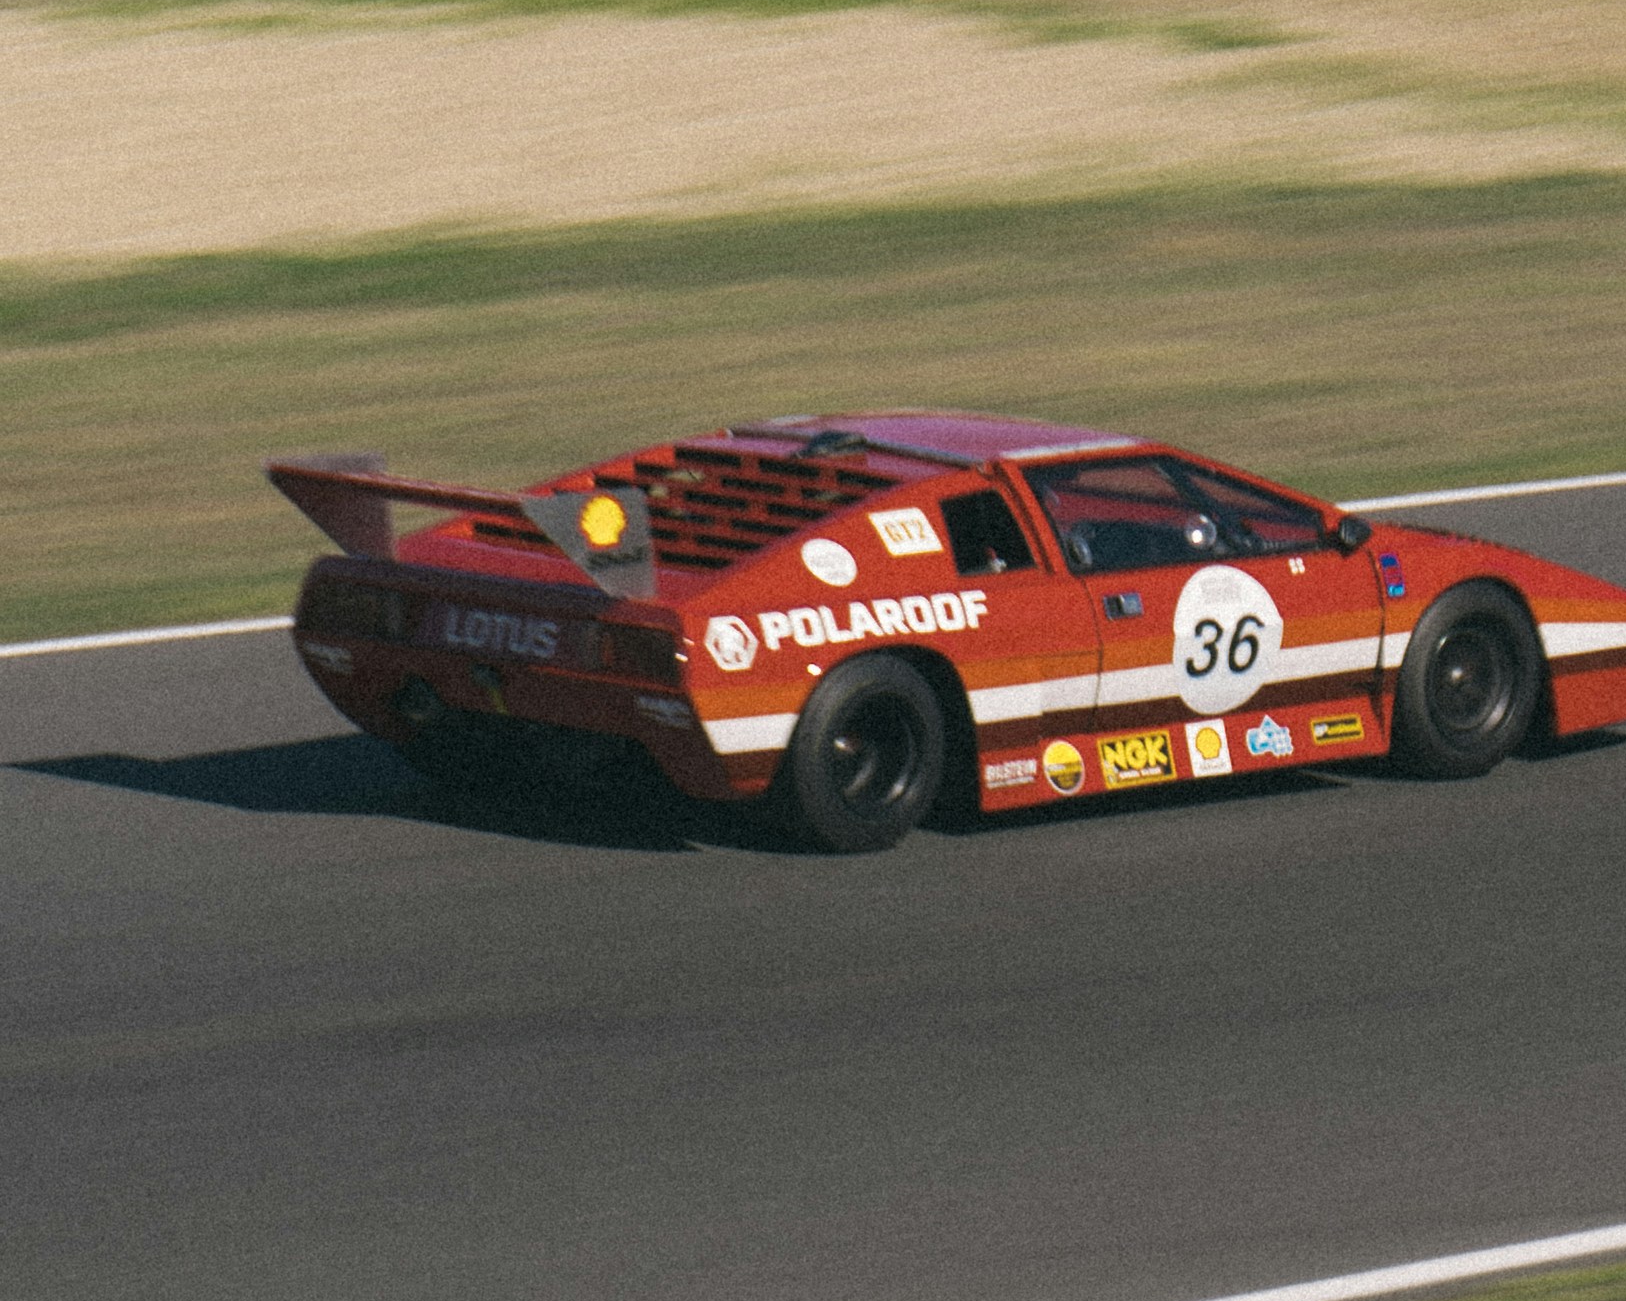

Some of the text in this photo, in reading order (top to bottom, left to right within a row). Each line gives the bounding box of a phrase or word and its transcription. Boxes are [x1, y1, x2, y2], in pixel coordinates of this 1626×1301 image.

[446, 603, 560, 658] LOTUS
[757, 589, 989, 651] POLAROOF
[1185, 614, 1265, 678] 36
[1103, 735, 1168, 771] NGK
